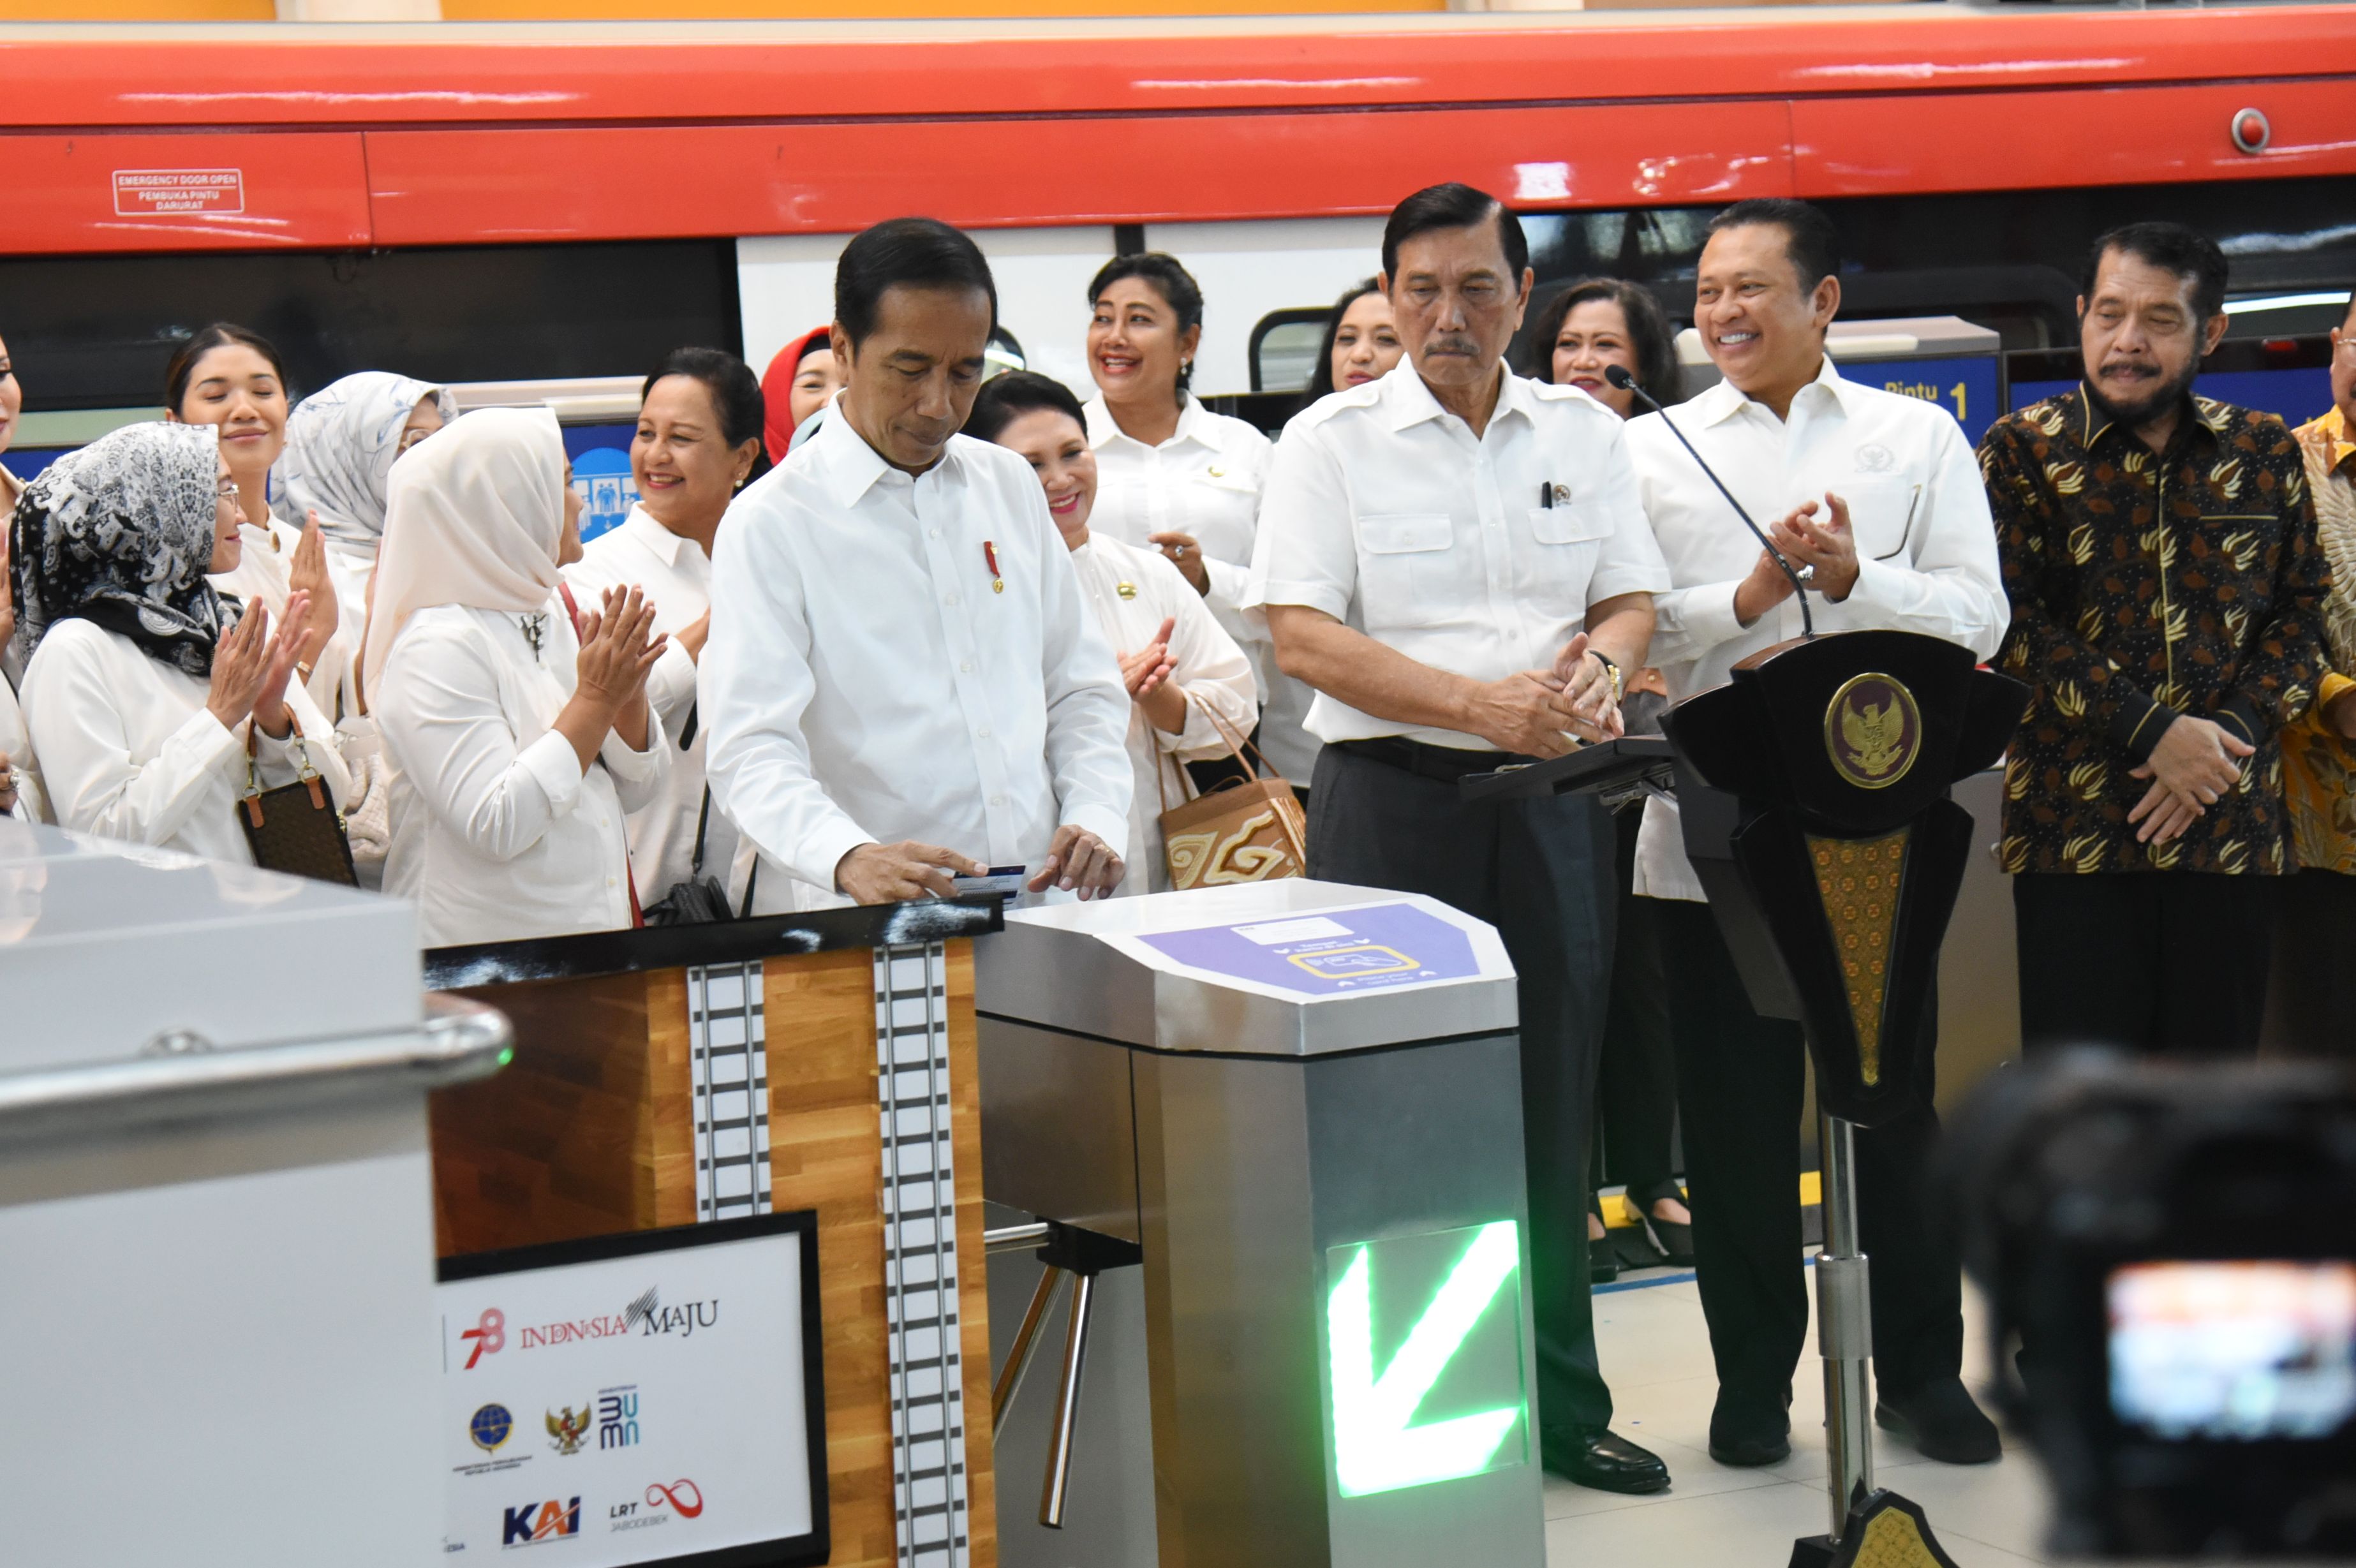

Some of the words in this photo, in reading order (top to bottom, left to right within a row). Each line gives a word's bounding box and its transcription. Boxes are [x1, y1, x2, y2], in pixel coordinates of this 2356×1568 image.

[118, 174, 178, 186] EMERGENCY
[180, 174, 209, 184] DOOR
[209, 174, 237, 184] OPEN
[138, 191, 189, 201] PEMBUKA
[189, 190, 219, 200] PINTU
[156, 200, 204, 211] DARURAT
[1950, 381, 1966, 422] 1
[642, 1299, 719, 1338] MAJU
[461, 1308, 506, 1370] 78
[502, 1495, 581, 1546] KAI
[610, 1502, 638, 1519] LRT
